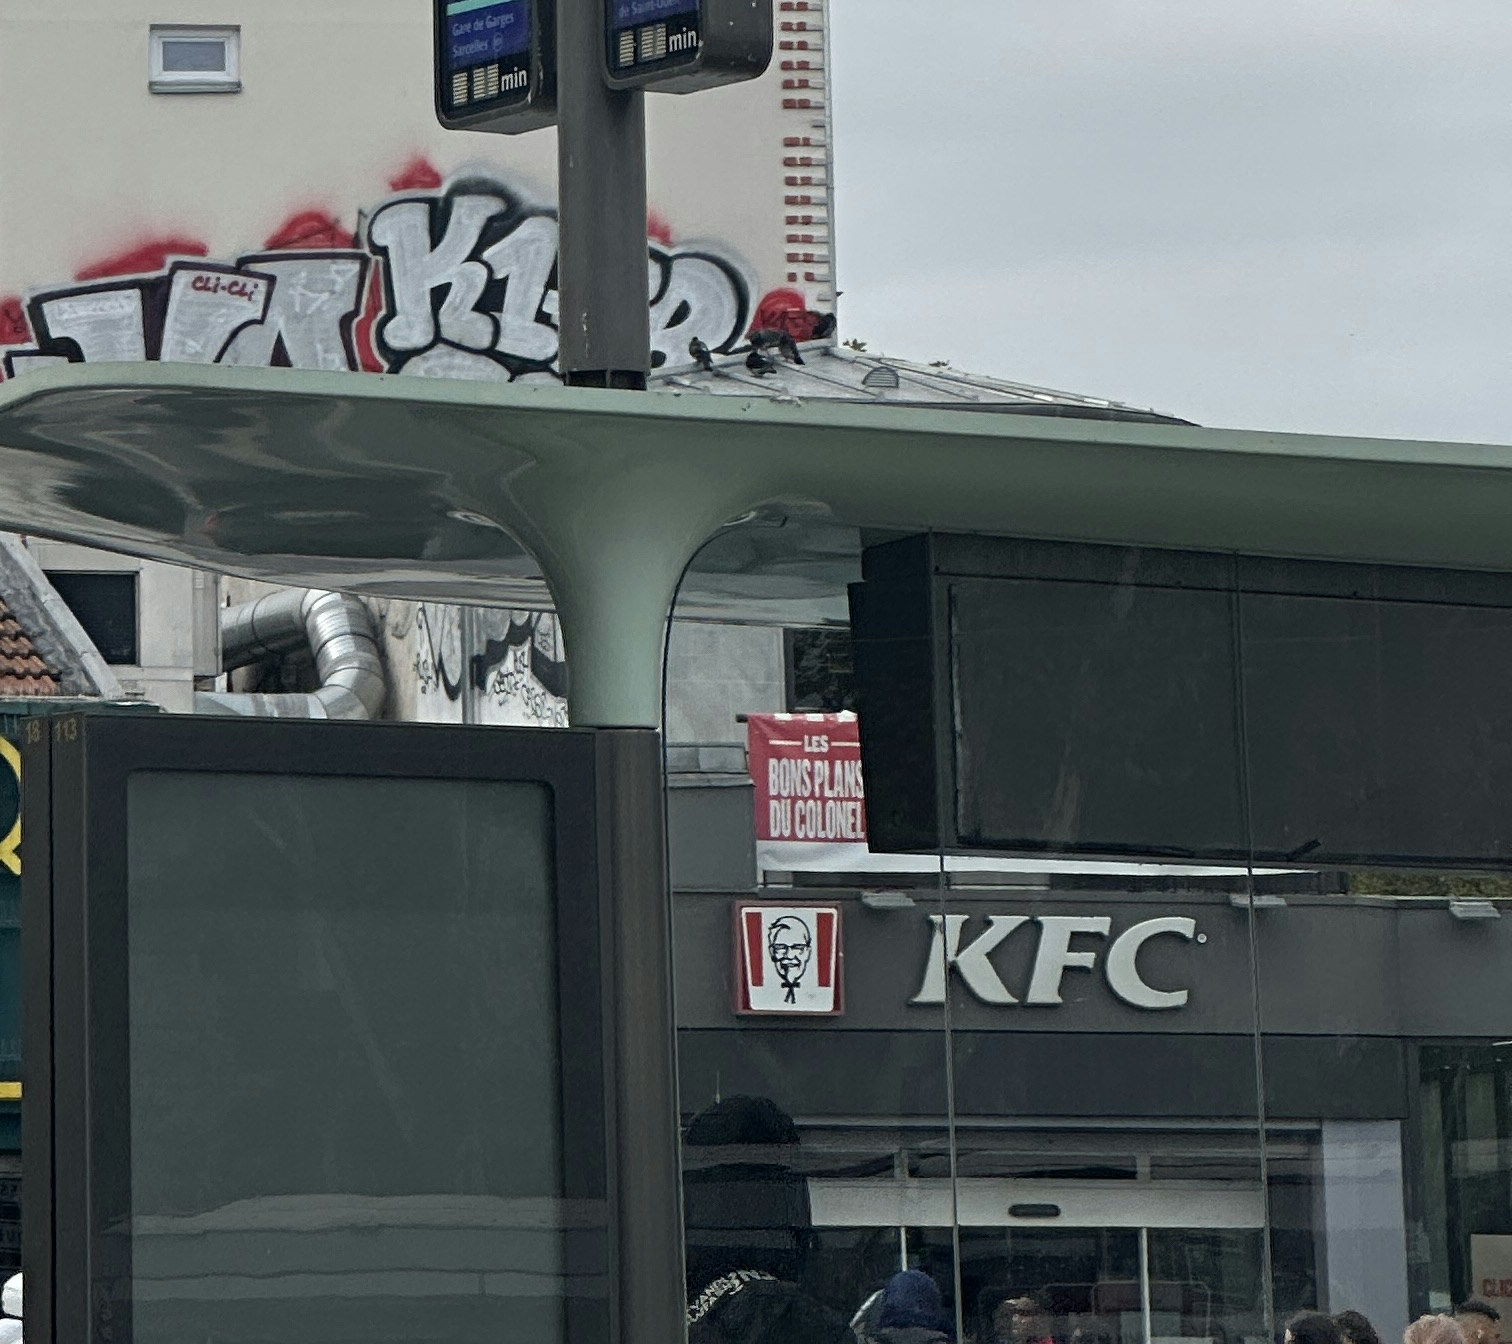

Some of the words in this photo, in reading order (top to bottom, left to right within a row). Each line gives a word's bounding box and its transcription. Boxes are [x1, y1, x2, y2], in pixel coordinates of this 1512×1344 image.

[668, 27, 697, 53] min
[501, 67, 527, 92] min
[803, 734, 829, 753] LES
[769, 758, 812, 797] BONS
[814, 759, 864, 799] PLANS
[769, 798, 791, 838] DU
[794, 799, 865, 840] COLONEL
[908, 913, 1197, 1009] KFC
